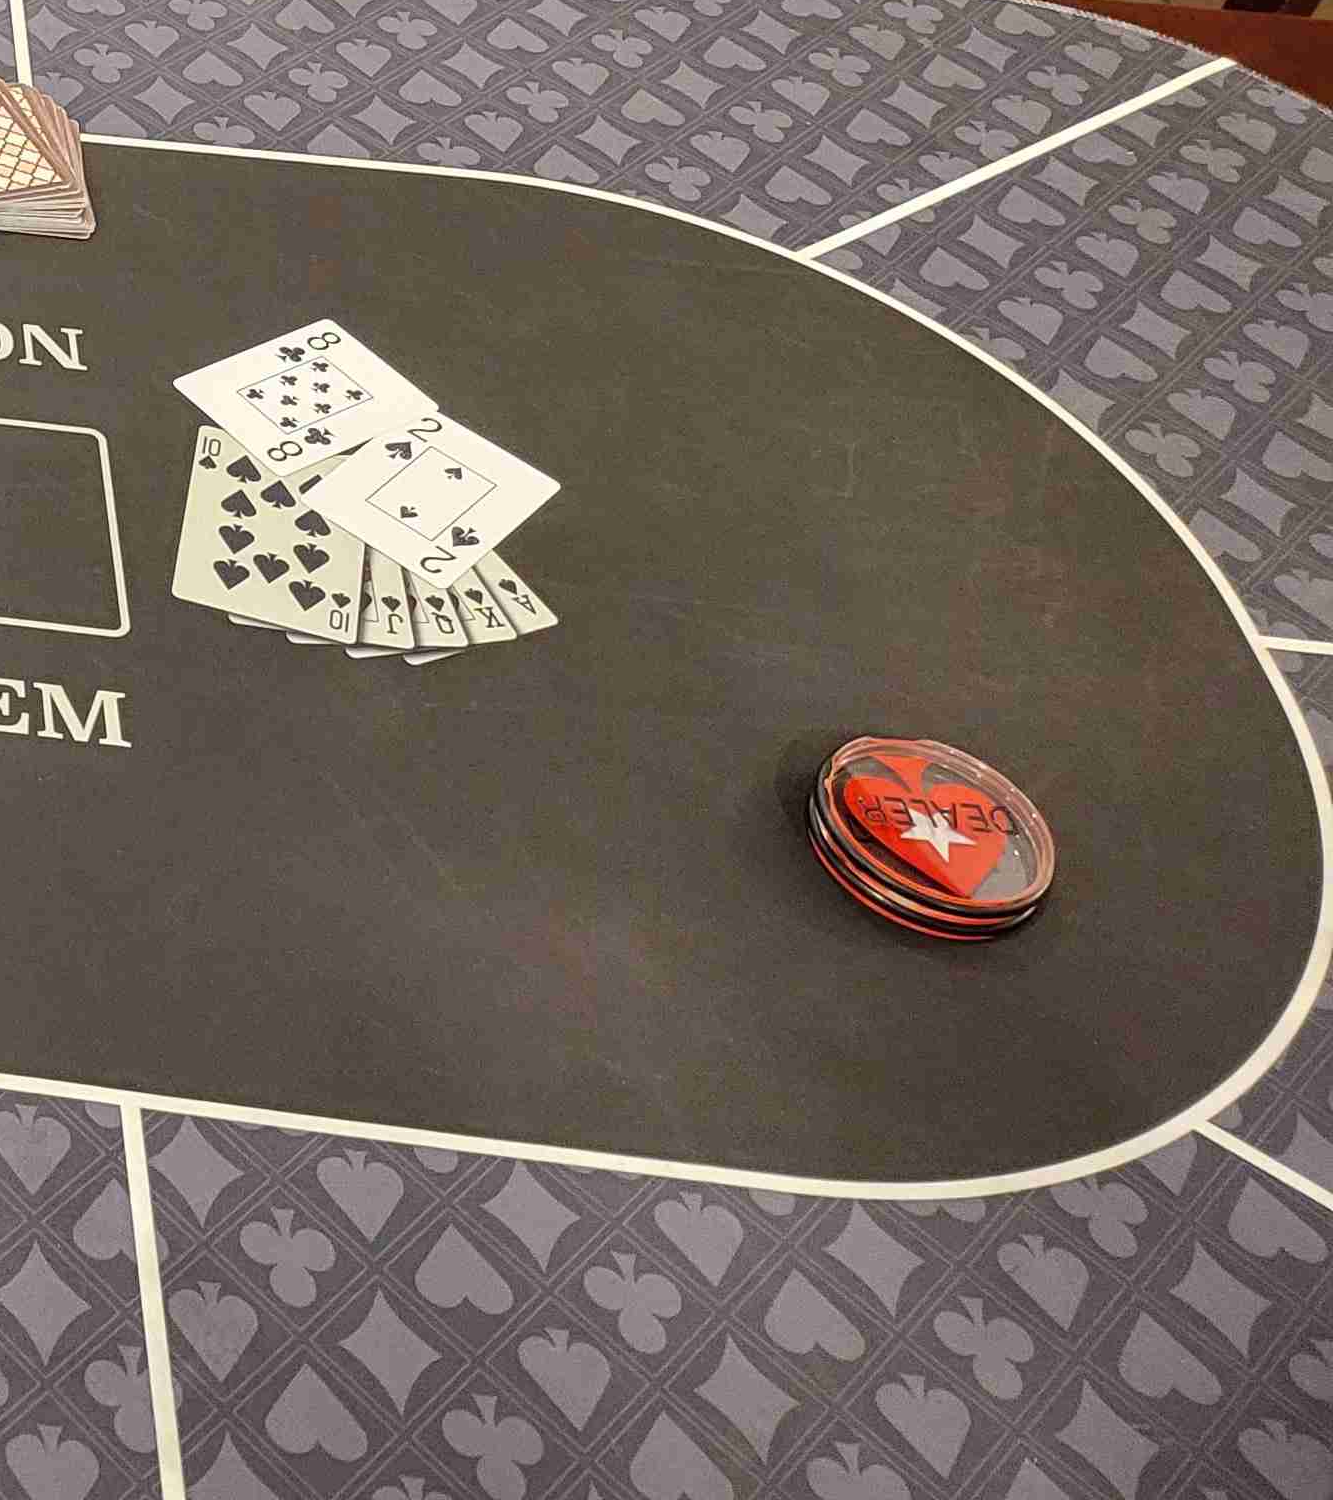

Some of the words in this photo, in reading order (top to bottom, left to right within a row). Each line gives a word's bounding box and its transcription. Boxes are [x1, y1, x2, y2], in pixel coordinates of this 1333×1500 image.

[307, 332, 341, 351] 8
[407, 417, 443, 443] 2
[202, 436, 222, 457] 10
[267, 441, 303, 462] 8
[420, 545, 457, 574] 2
[512, 594, 537, 615] A
[328, 609, 350, 633] 10
[386, 613, 404, 634] J
[431, 612, 455, 635] Q
[474, 606, 505, 629] K
[862, 795, 1017, 837] DEALER
